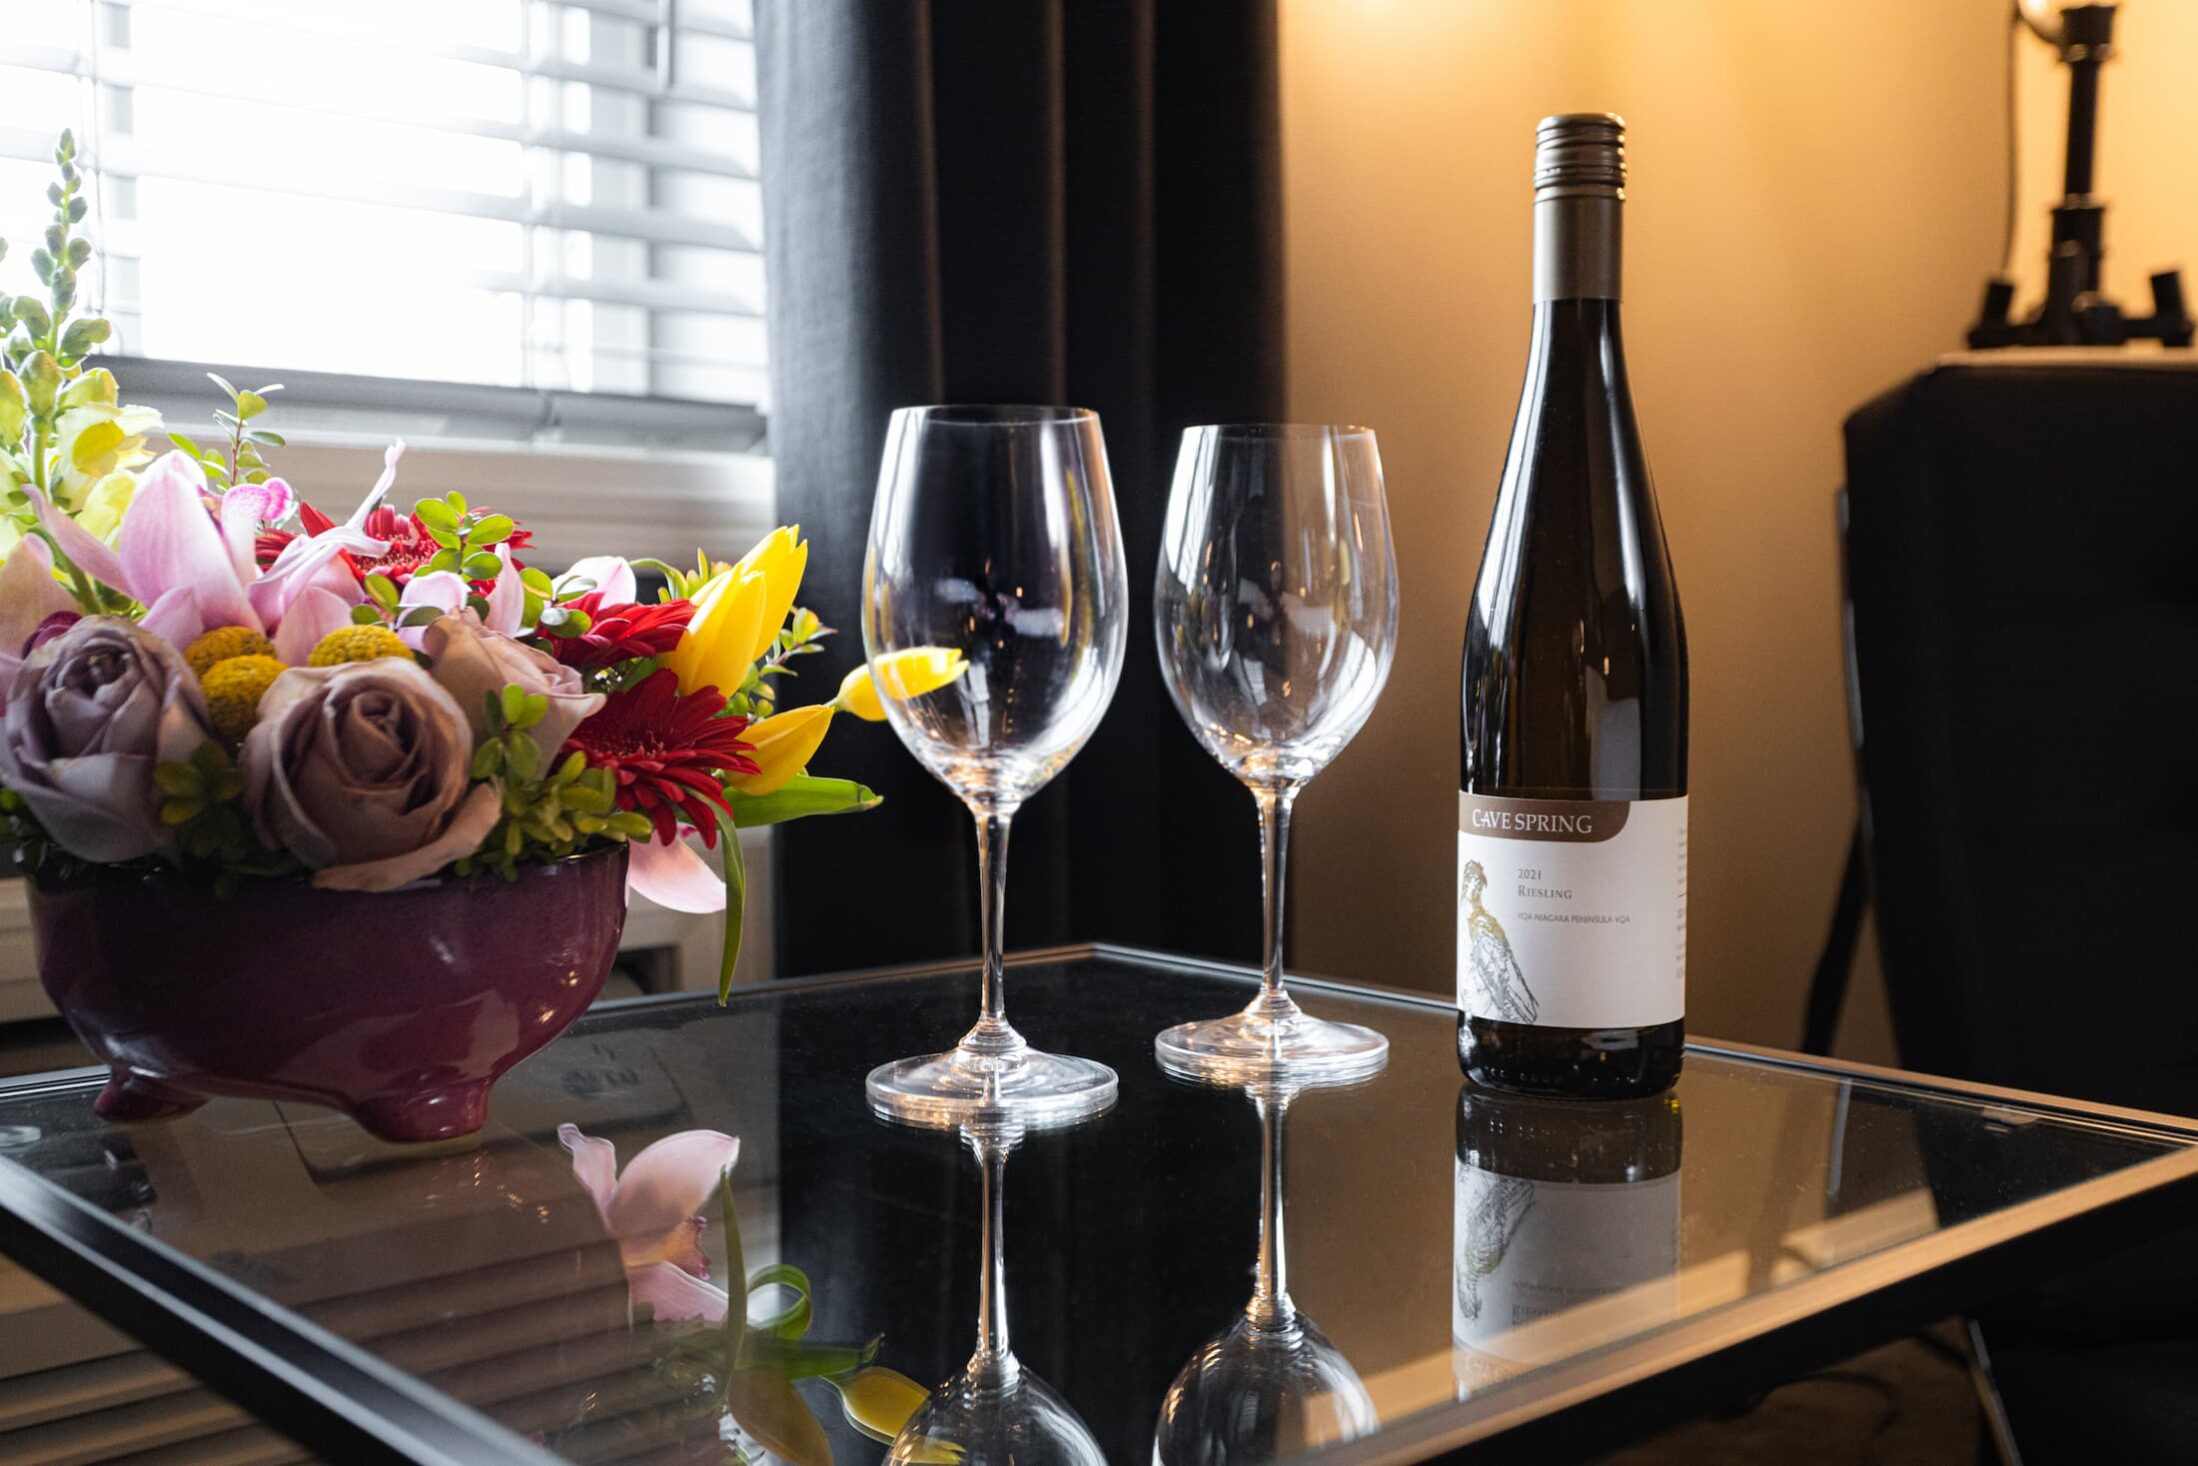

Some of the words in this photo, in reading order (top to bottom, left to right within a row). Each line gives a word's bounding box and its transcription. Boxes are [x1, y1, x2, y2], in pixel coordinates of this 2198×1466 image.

[1472, 808, 1512, 830] CAVE
[1514, 812, 1593, 834] SPRING
[1517, 868, 1542, 880] 2021
[1534, 913, 1569, 923] NIAGARA
[1571, 914, 1613, 924] PENINSULA
